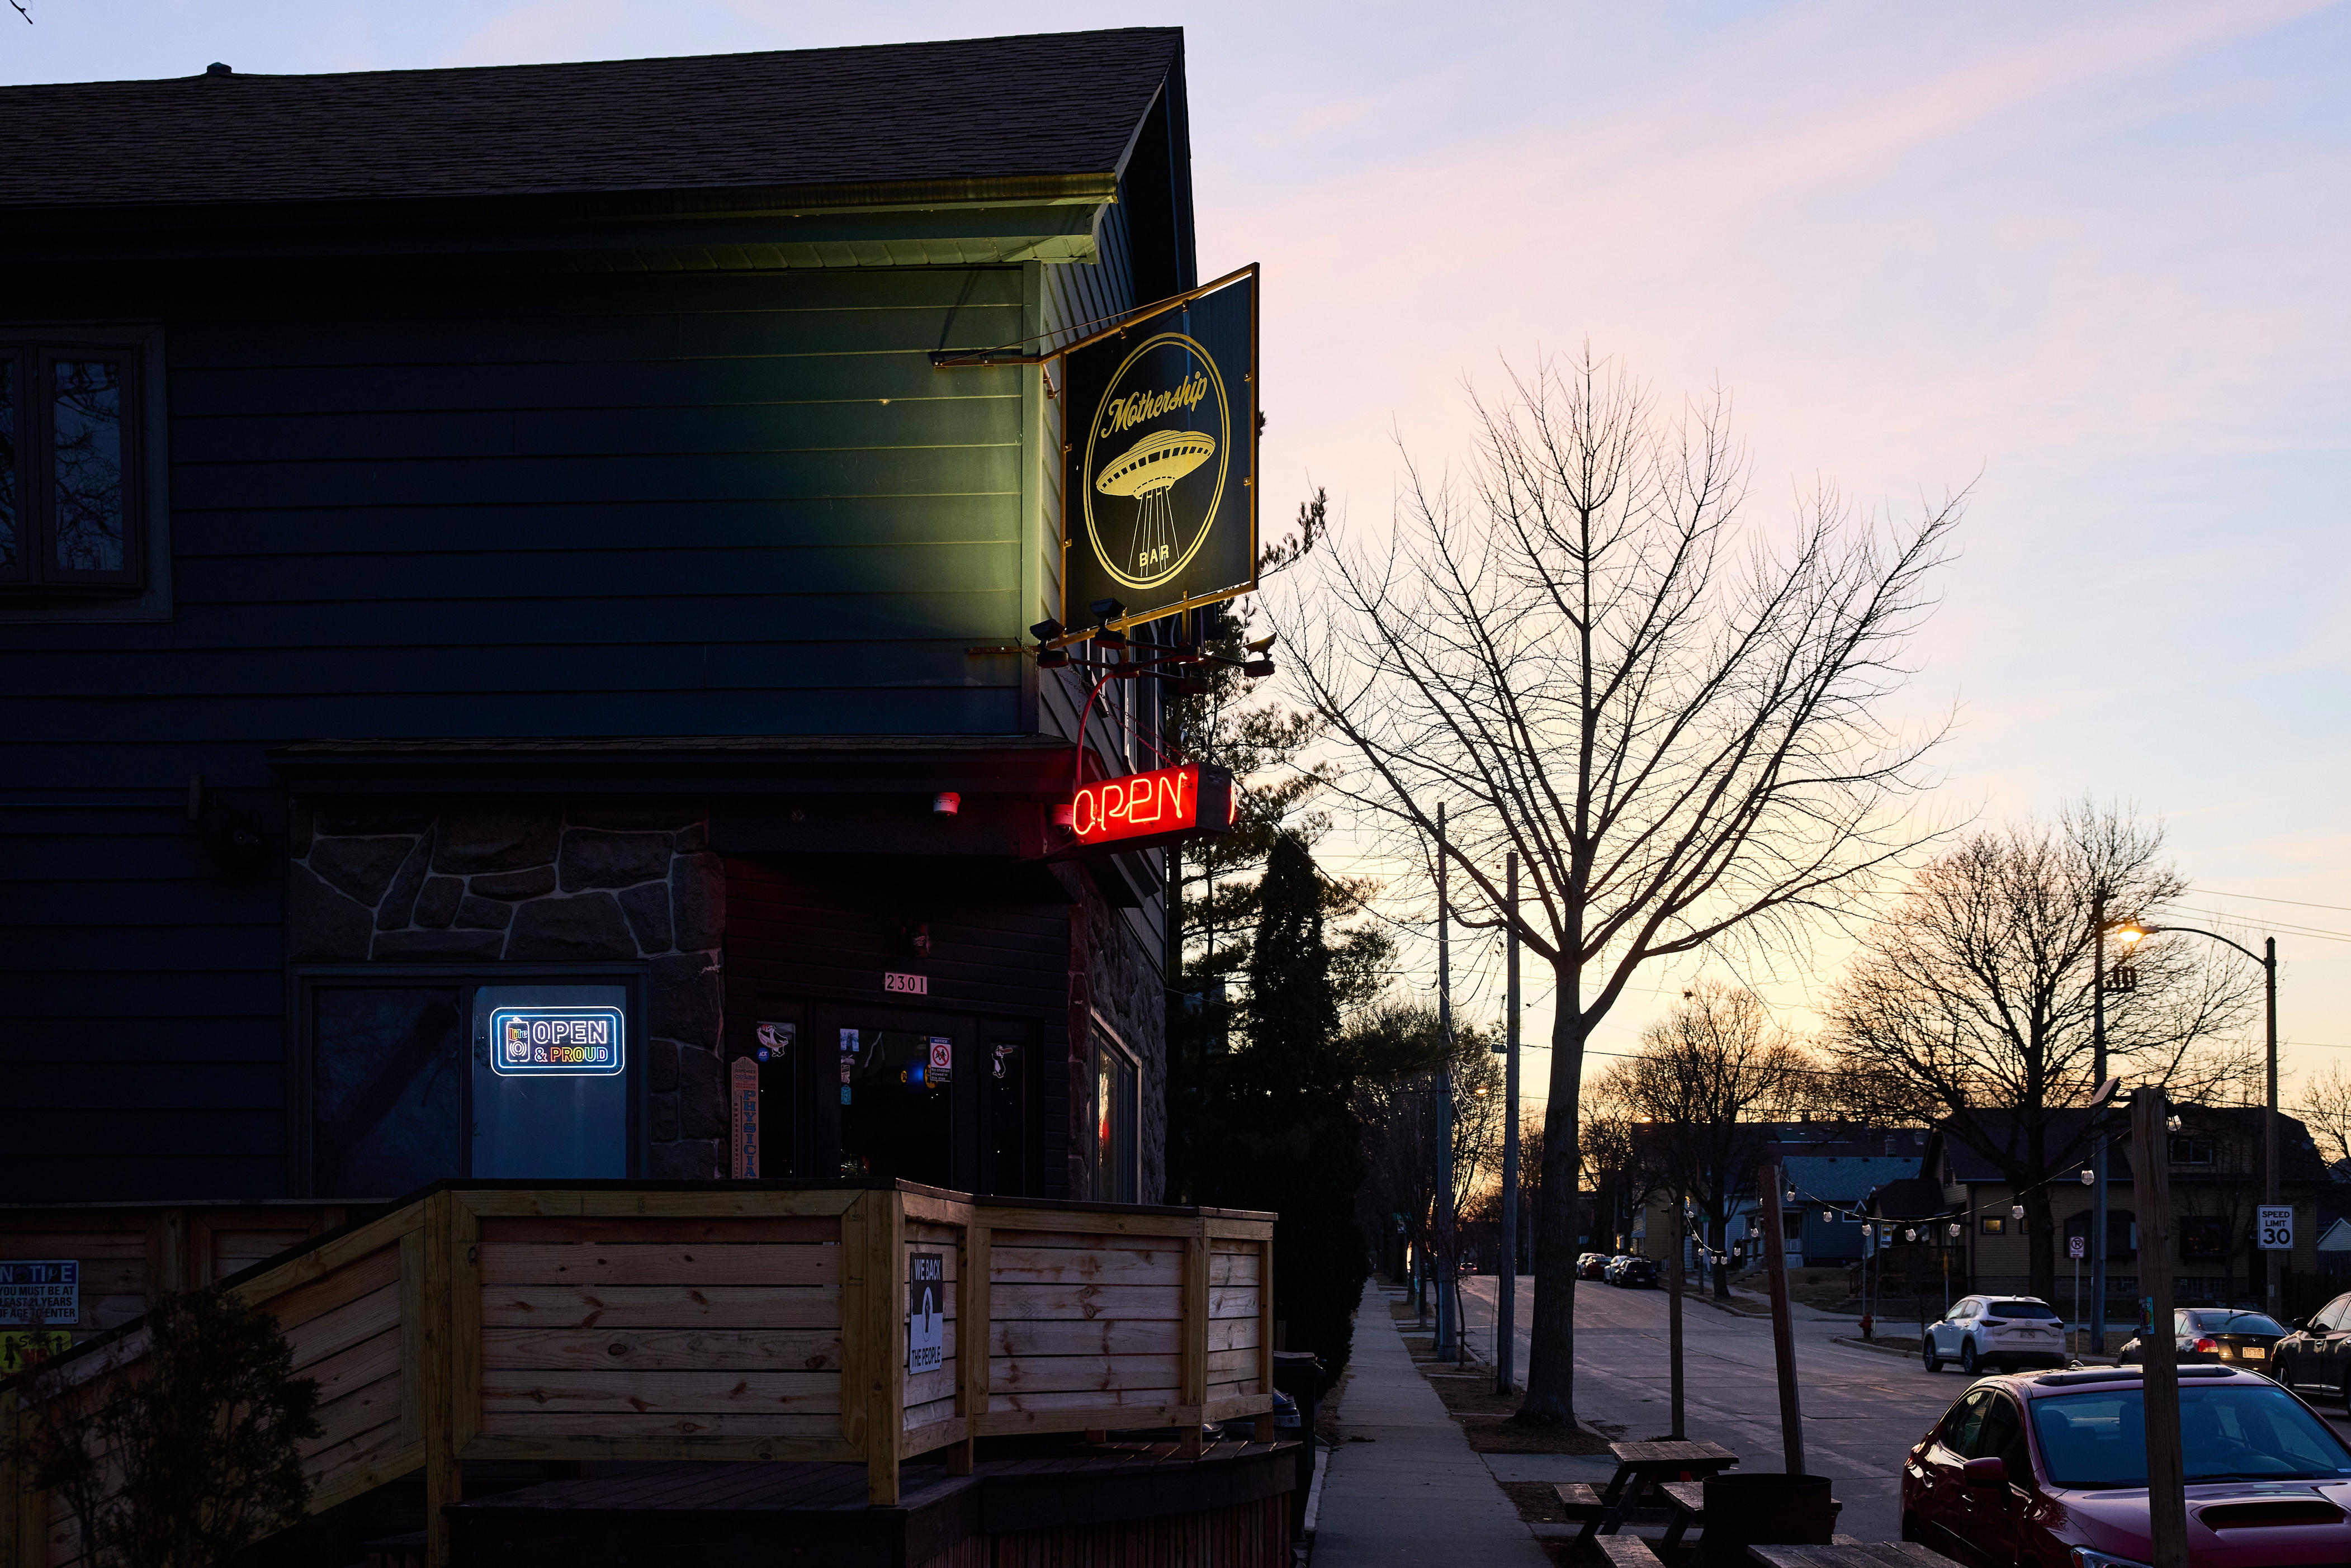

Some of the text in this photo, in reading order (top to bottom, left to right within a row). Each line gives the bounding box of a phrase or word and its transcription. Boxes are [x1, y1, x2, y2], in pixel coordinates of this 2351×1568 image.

[1100, 371, 1208, 439] Mothership
[1139, 544, 1170, 567] BAR
[1073, 772, 1187, 835] OPEN
[887, 974, 924, 992] 2301
[508, 1027, 528, 1041] Lite
[532, 1020, 608, 1044] OPEN
[534, 1046, 608, 1063] & PROUD
[743, 1089, 756, 1179] PHYSICIA
[2263, 1228, 2291, 1244] 30
[915, 1259, 941, 1281] WE BACK
[19, 1286, 45, 1295] MUST
[48, 1286, 60, 1295] BE
[62, 1286, 74, 1295] AT
[29, 1297, 38, 1306] 21
[41, 1297, 72, 1306] YEARS
[10, 1309, 29, 1318] AGE
[45, 1309, 75, 1318] ENTER
[912, 1346, 940, 1368] THE PEOPLE
